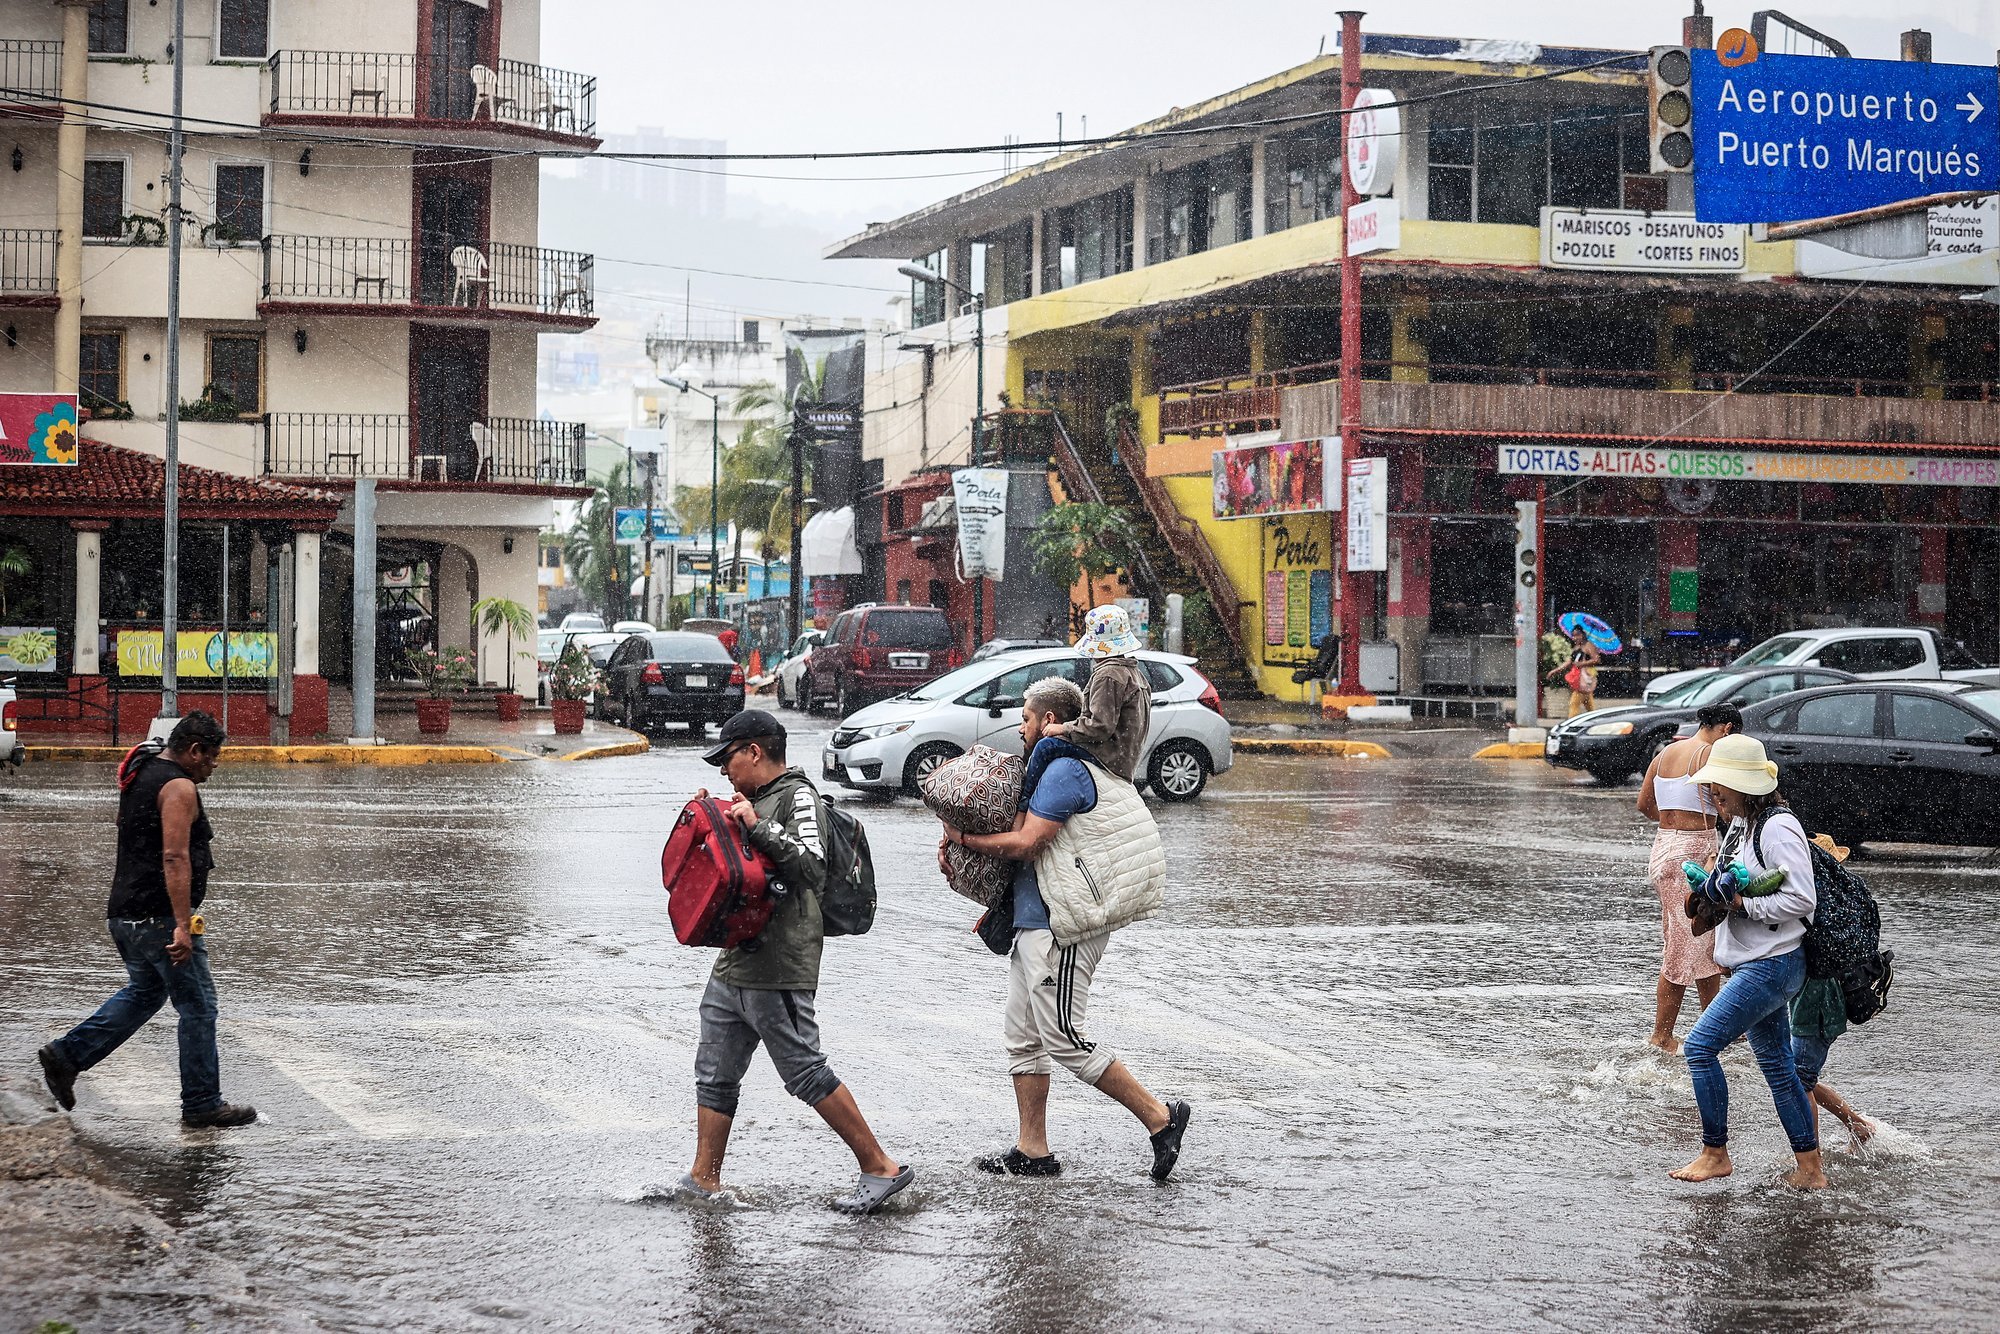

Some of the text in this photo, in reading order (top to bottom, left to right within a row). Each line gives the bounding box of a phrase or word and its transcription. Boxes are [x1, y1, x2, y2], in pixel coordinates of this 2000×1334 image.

[1718, 79, 1938, 124] Aeropuerto
[1718, 132, 1980, 183] Puerto Marqués
[1562, 219, 1724, 239] MARISCOS DESAYUNOS
[1927, 225, 1983, 238] taurante
[1562, 242, 1739, 262] POZOLE CORTES FINOS
[1947, 242, 1983, 253] costa
[1505, 448, 1997, 483] TORTAS ALITAS QUESOS HAMBURGUESAS FRAPPES
[966, 484, 1001, 499] Perla
[1273, 527, 1321, 569] Perla
